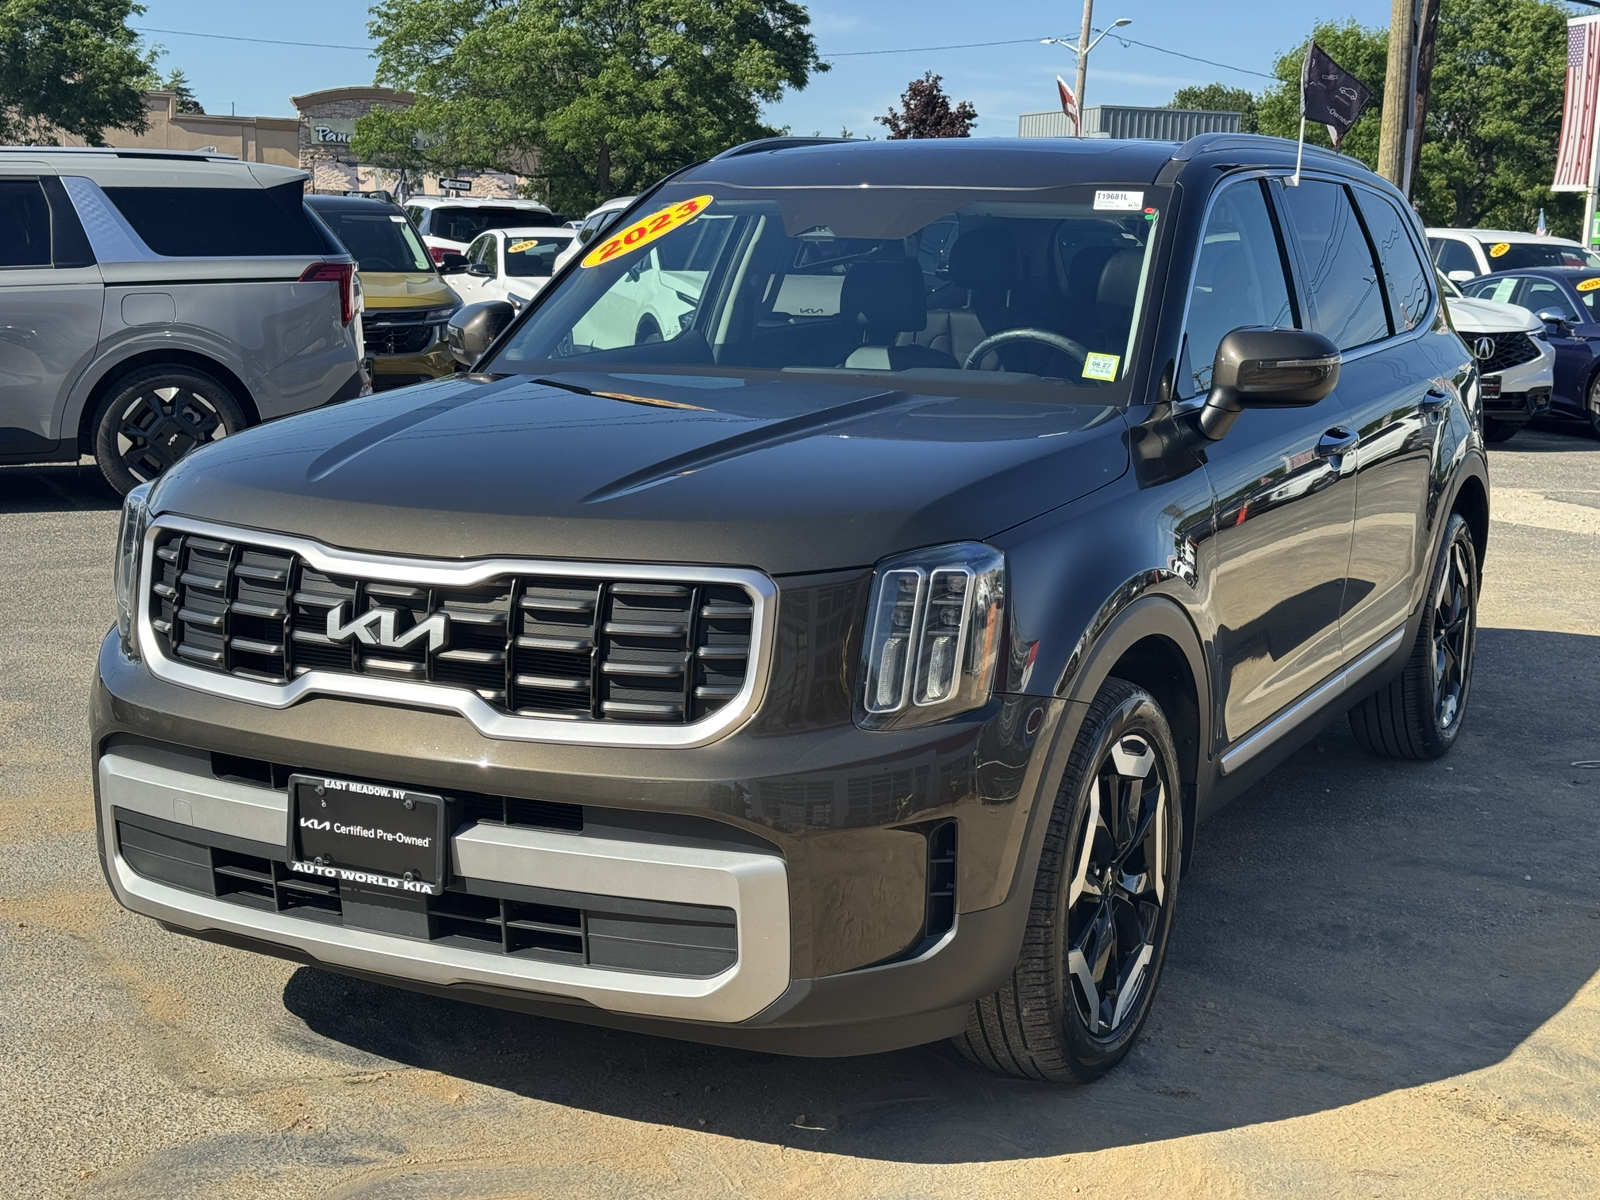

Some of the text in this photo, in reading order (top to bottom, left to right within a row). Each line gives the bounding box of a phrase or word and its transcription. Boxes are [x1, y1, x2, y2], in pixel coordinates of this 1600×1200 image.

[1097, 192, 1129, 201] T19681L
[598, 200, 700, 262] 2023
[1580, 279, 1600, 290] 202
[326, 602, 450, 652] KIA
[324, 780, 347, 791] EAST
[392, 790, 406, 800] NY
[300, 817, 331, 831] KIA
[333, 823, 375, 839] Certified
[292, 861, 433, 895] AUTO WORLD KIA
